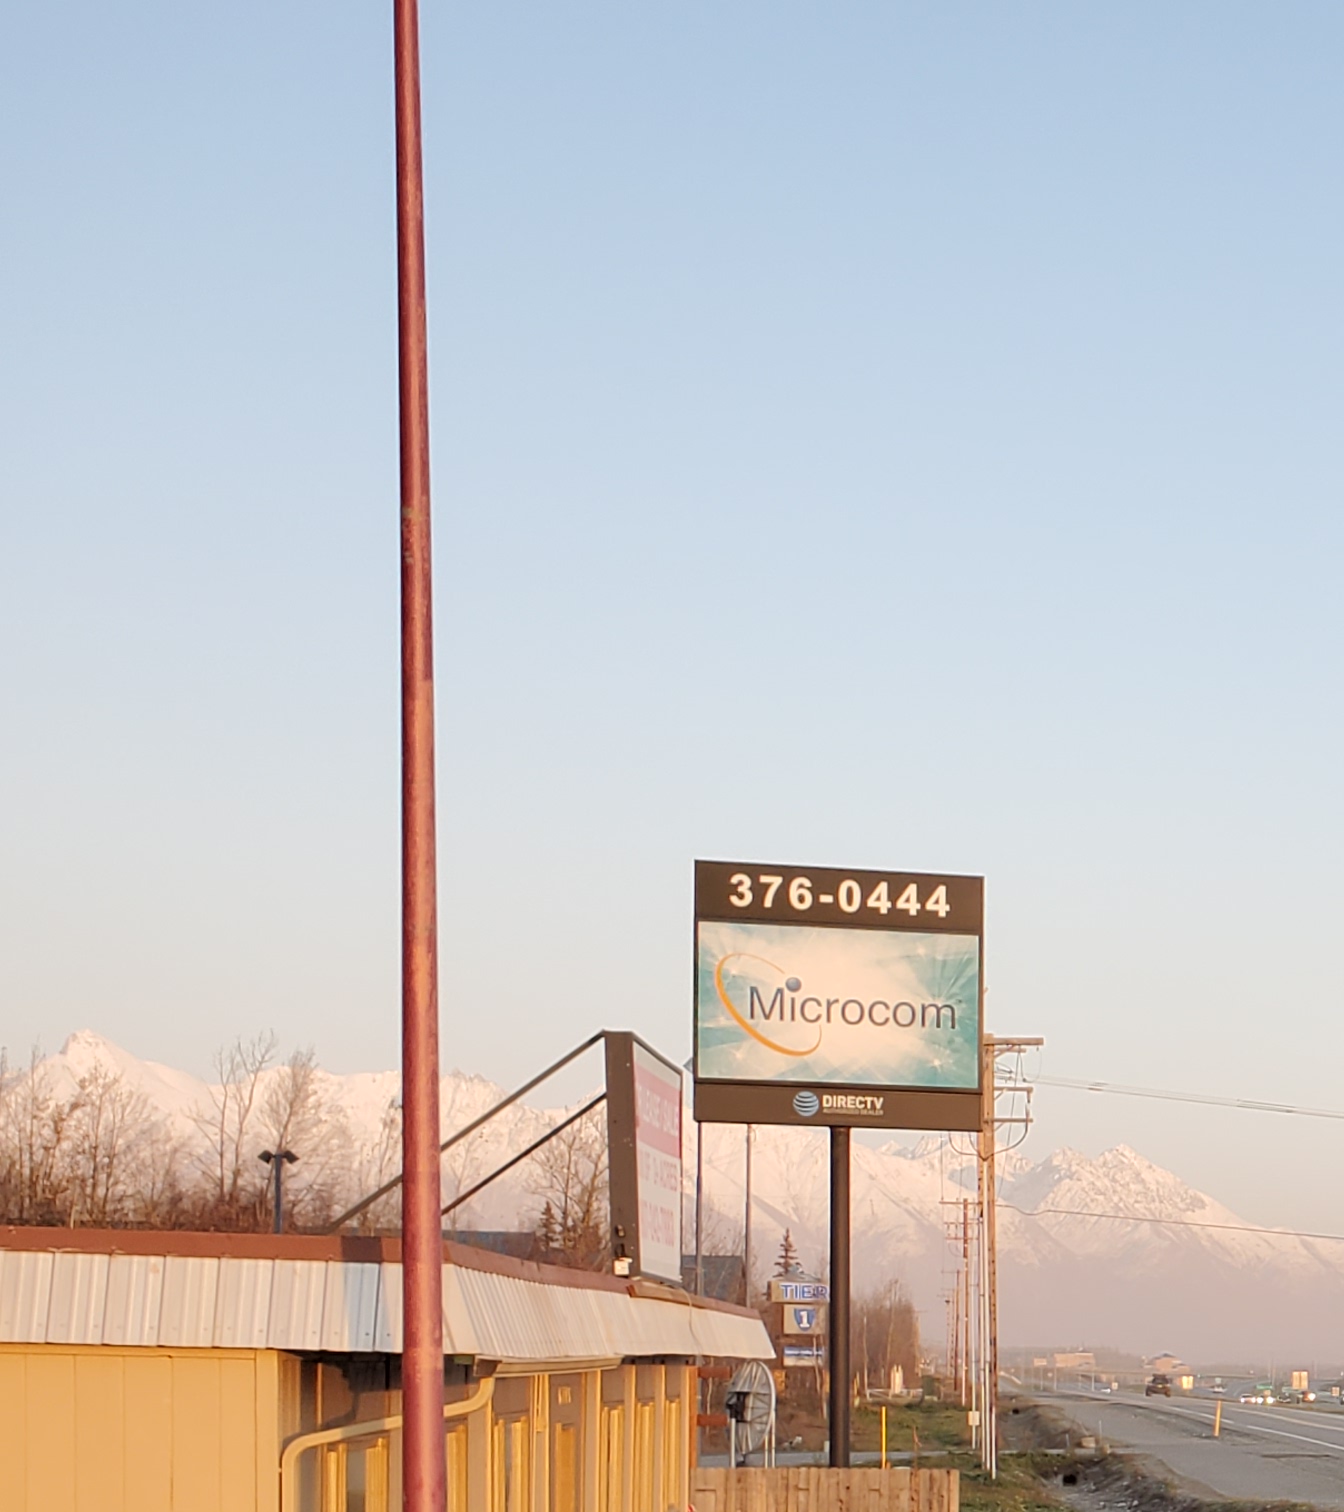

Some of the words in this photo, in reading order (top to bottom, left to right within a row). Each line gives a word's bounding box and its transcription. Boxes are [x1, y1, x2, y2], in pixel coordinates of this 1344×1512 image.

[729, 873, 950, 918] 376-0444
[748, 977, 957, 1030] Microcom
[822, 1094, 884, 1110] DIRECTV
[781, 1284, 828, 1299] TIER
[799, 1311, 811, 1328] 1
